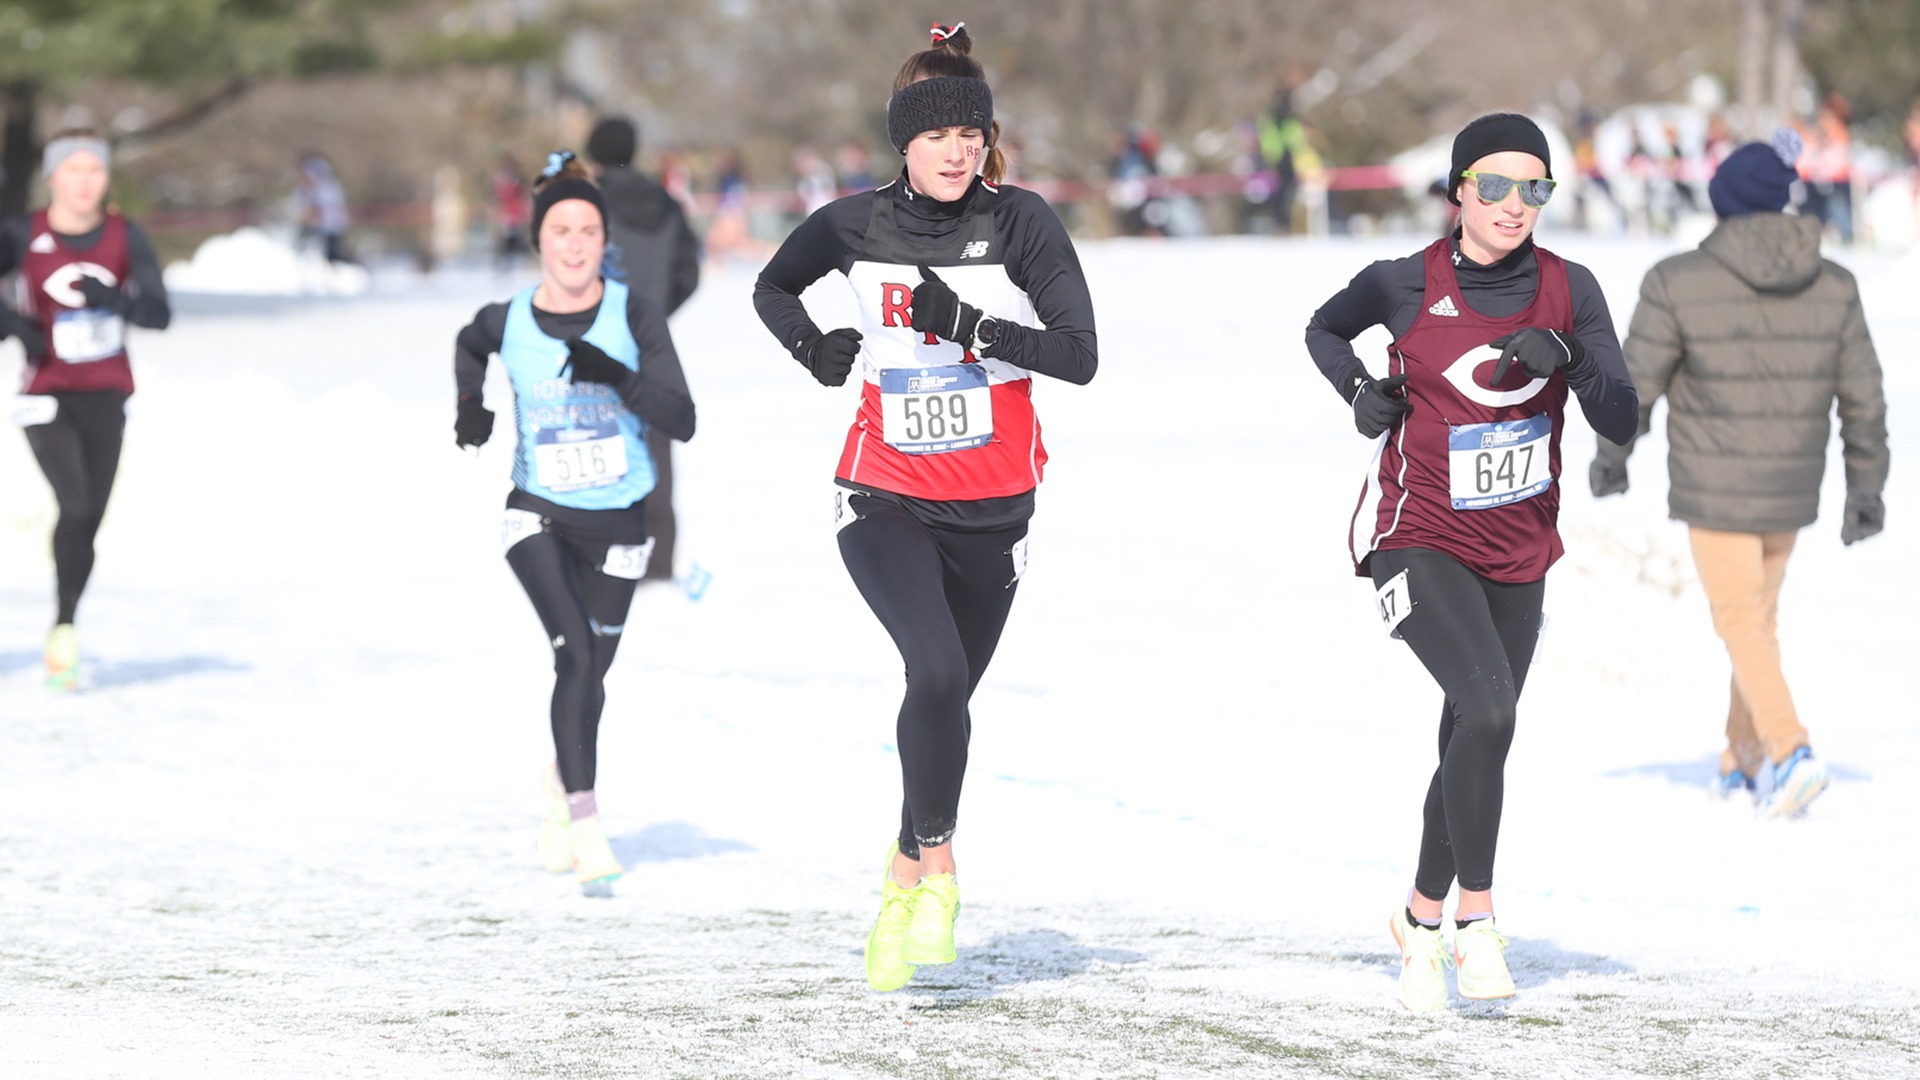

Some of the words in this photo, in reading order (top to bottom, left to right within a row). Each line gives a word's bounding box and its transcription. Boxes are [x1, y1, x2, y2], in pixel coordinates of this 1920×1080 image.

[1429, 306, 1460, 317] adidas
[903, 393, 968, 441] 589
[556, 444, 607, 481] 516
[1475, 444, 1534, 495] 647
